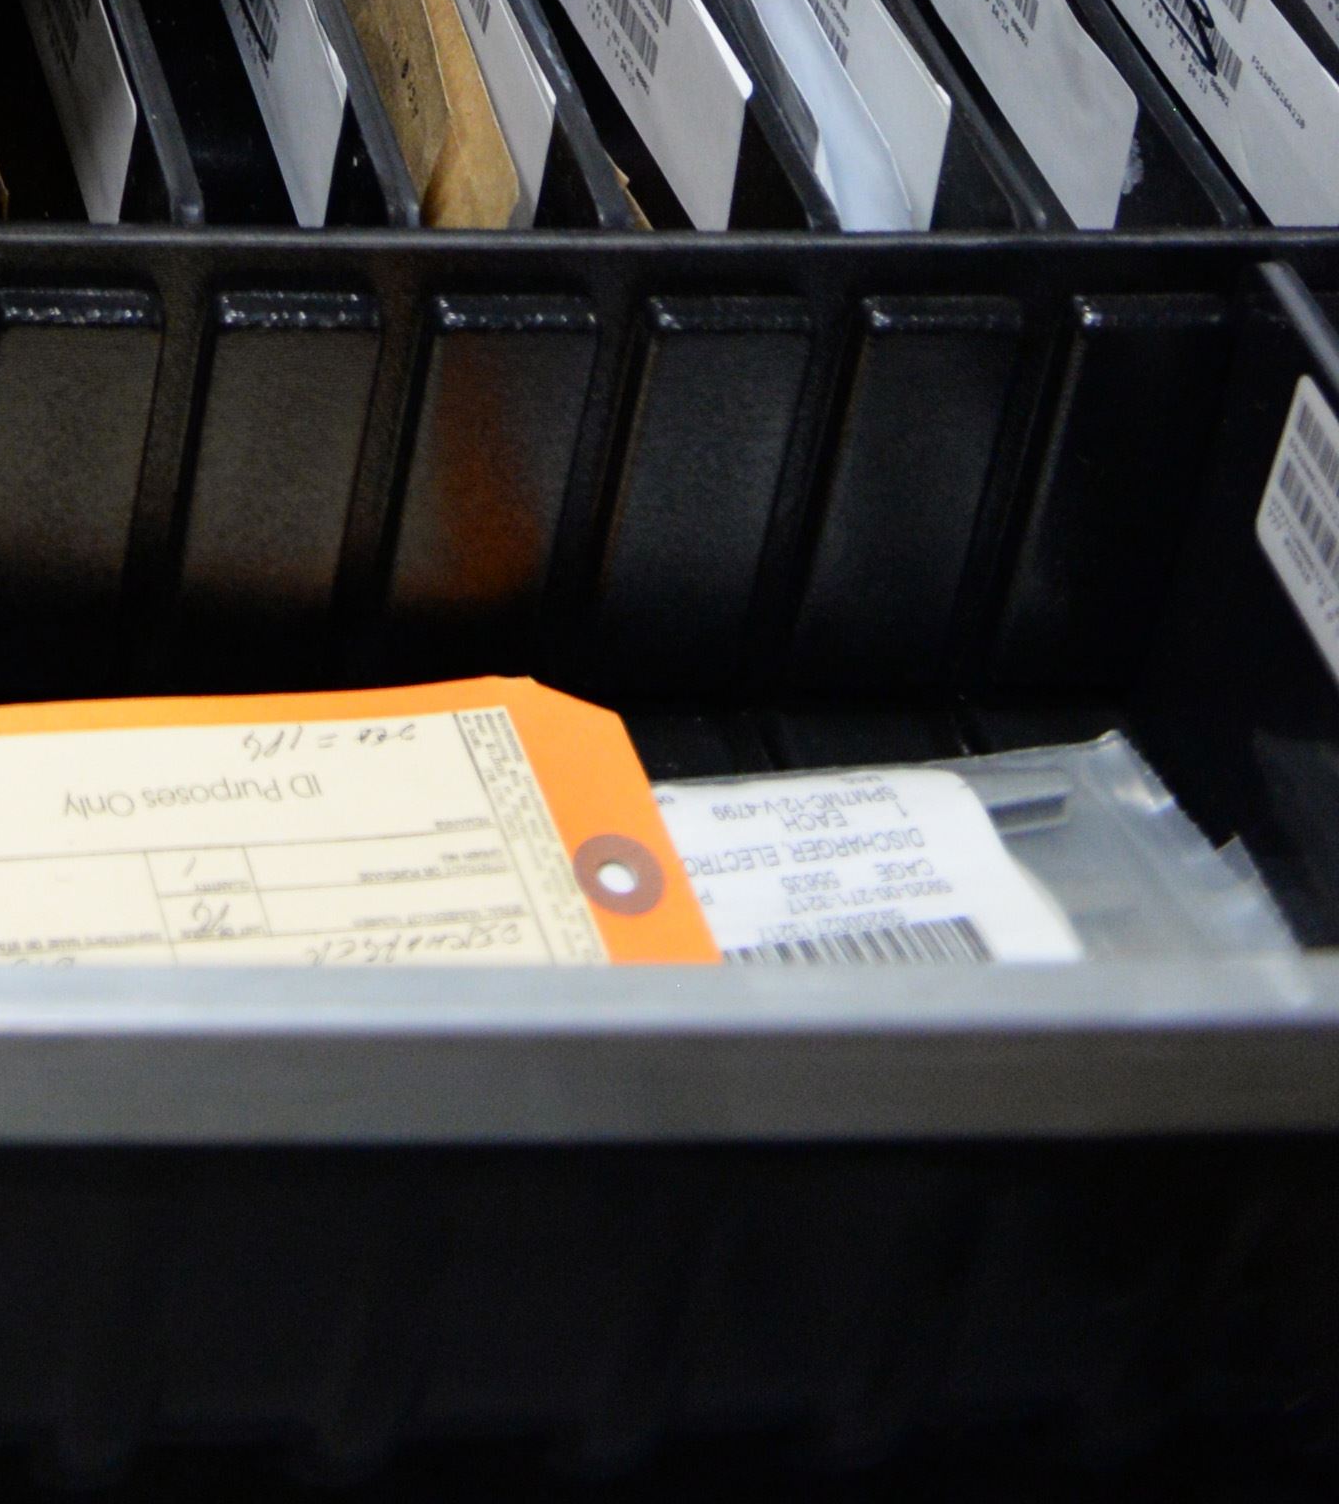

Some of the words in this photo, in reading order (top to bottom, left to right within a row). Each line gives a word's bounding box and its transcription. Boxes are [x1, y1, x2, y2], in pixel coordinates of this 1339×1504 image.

[141, 776, 277, 809] Purposes
[290, 773, 321, 798] ID
[62, 792, 135, 820] Only
[782, 809, 847, 832] EACH
[874, 859, 935, 881] CAGE
